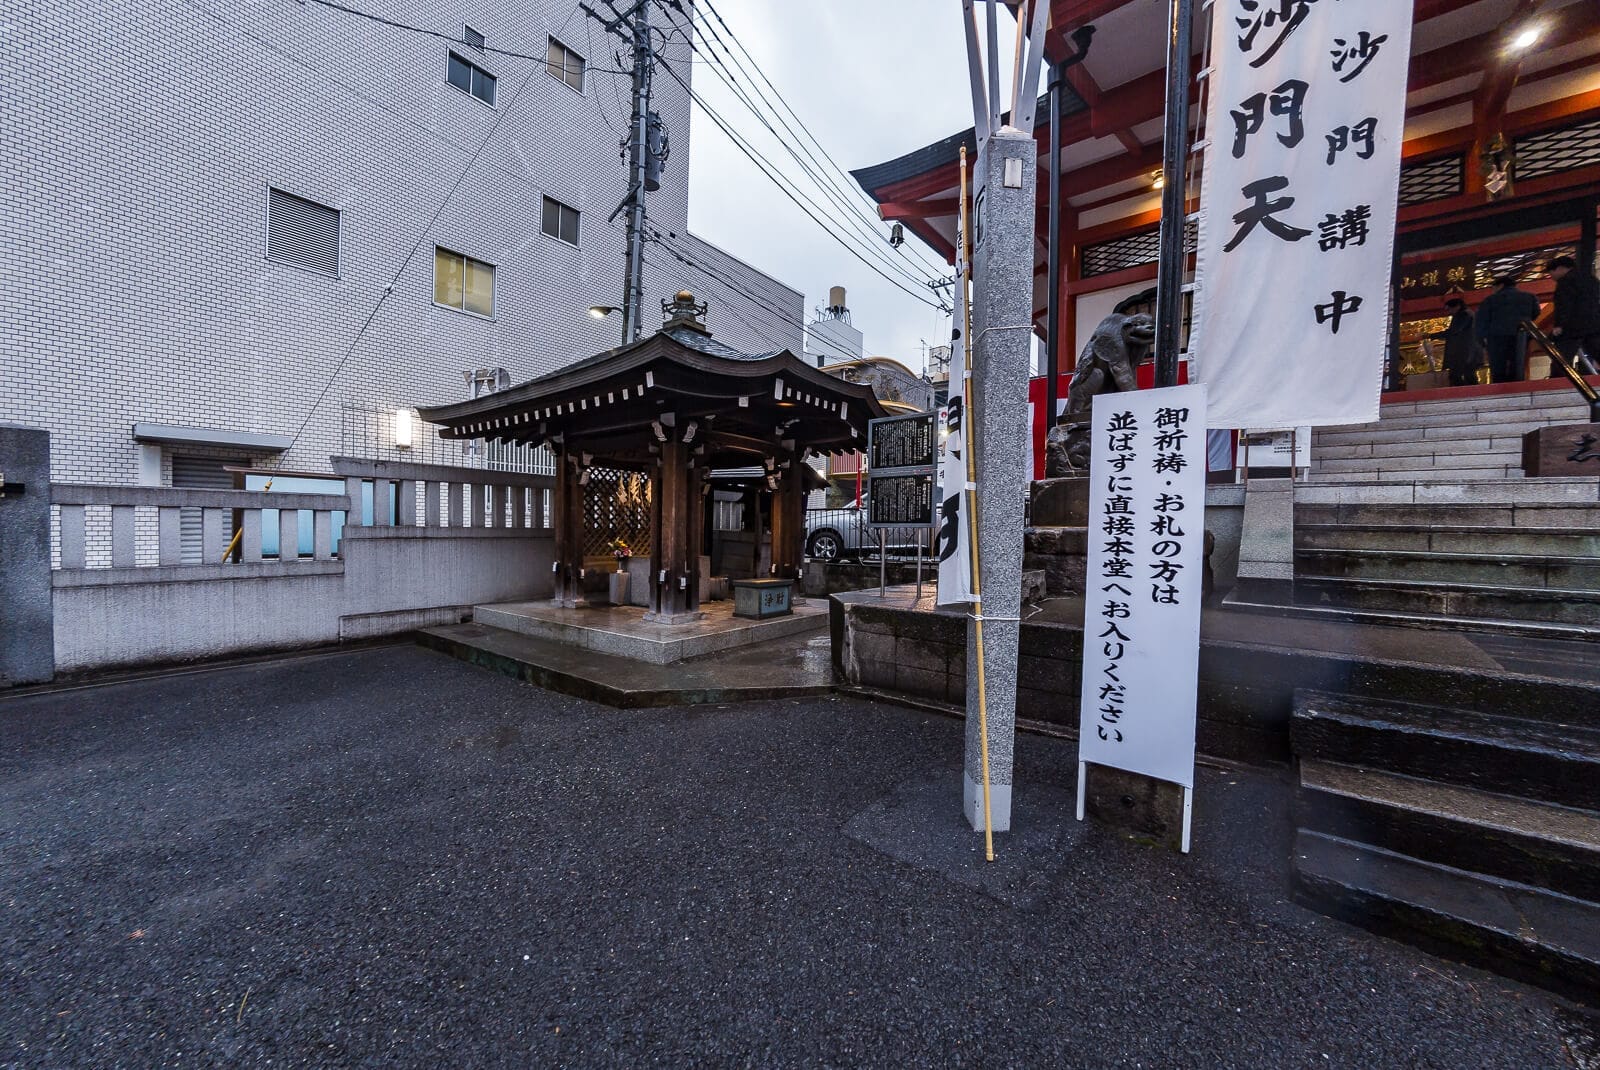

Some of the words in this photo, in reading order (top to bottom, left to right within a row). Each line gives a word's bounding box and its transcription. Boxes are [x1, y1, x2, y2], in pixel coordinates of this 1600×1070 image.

[1223, 0, 1314, 252] 沙門天
[1314, 31, 1388, 334] 沙門講中
[1097, 411, 1138, 742] 並ばずに直接本堂へお入りください
[1149, 408, 1189, 604] 御祈祷・お札の方は
